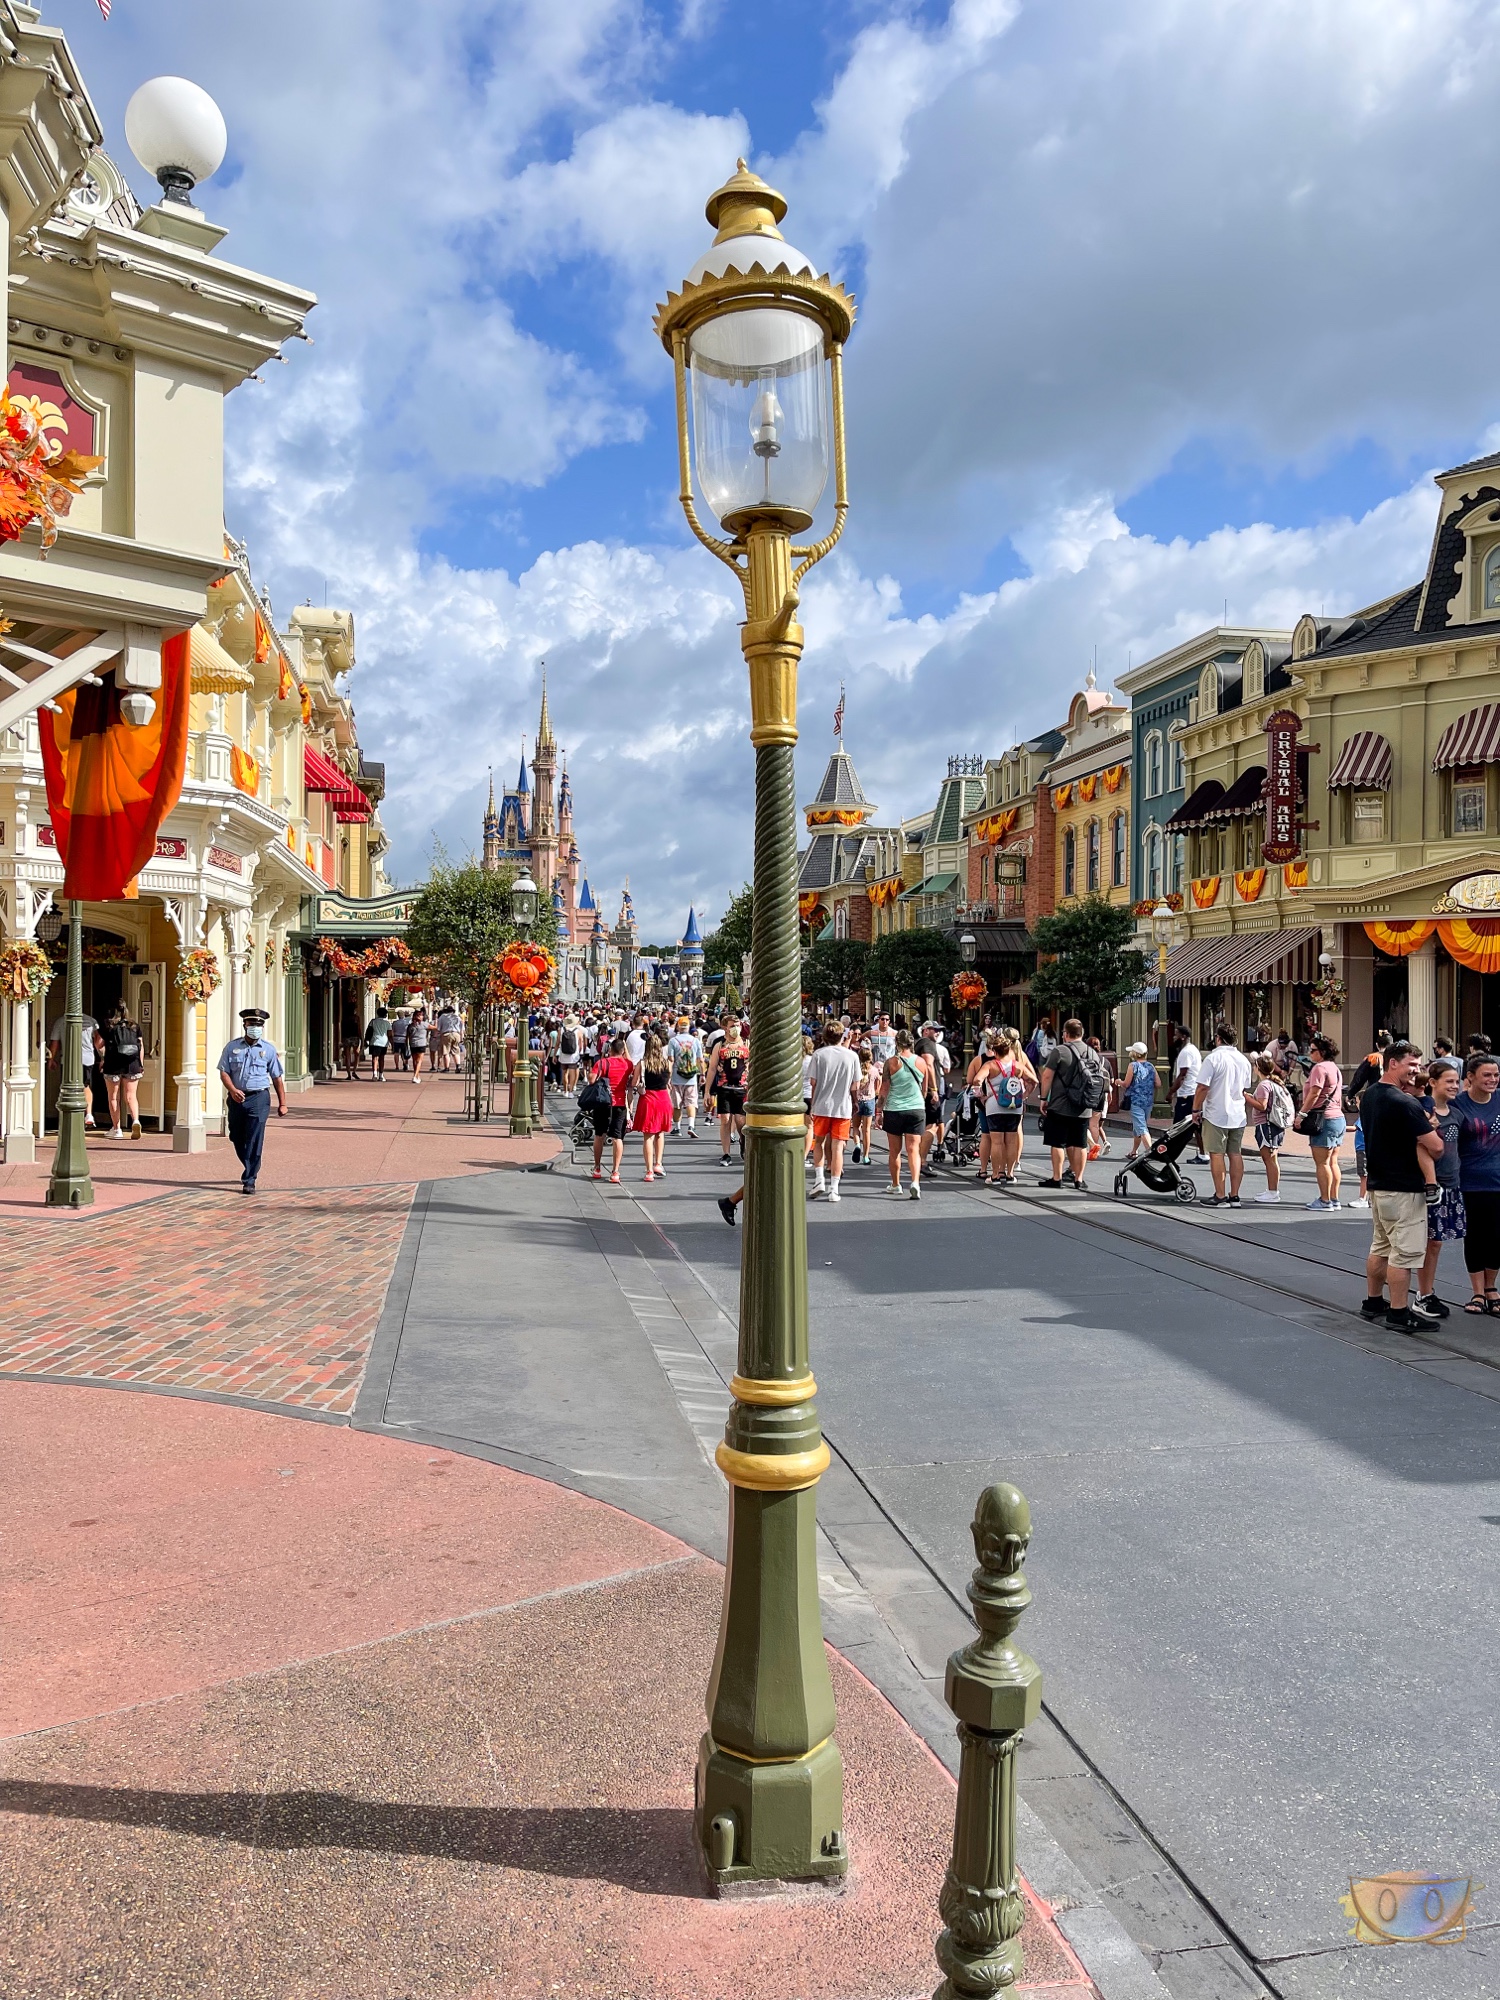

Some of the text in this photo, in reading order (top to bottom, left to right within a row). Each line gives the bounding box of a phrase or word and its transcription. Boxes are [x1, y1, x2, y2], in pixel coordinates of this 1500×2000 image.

[1276, 731, 1291, 842] CRYSTAL ARTS
[356, 911, 373, 920] Main
[375, 907, 396, 920] Street
[730, 1058, 738, 1069] 8
